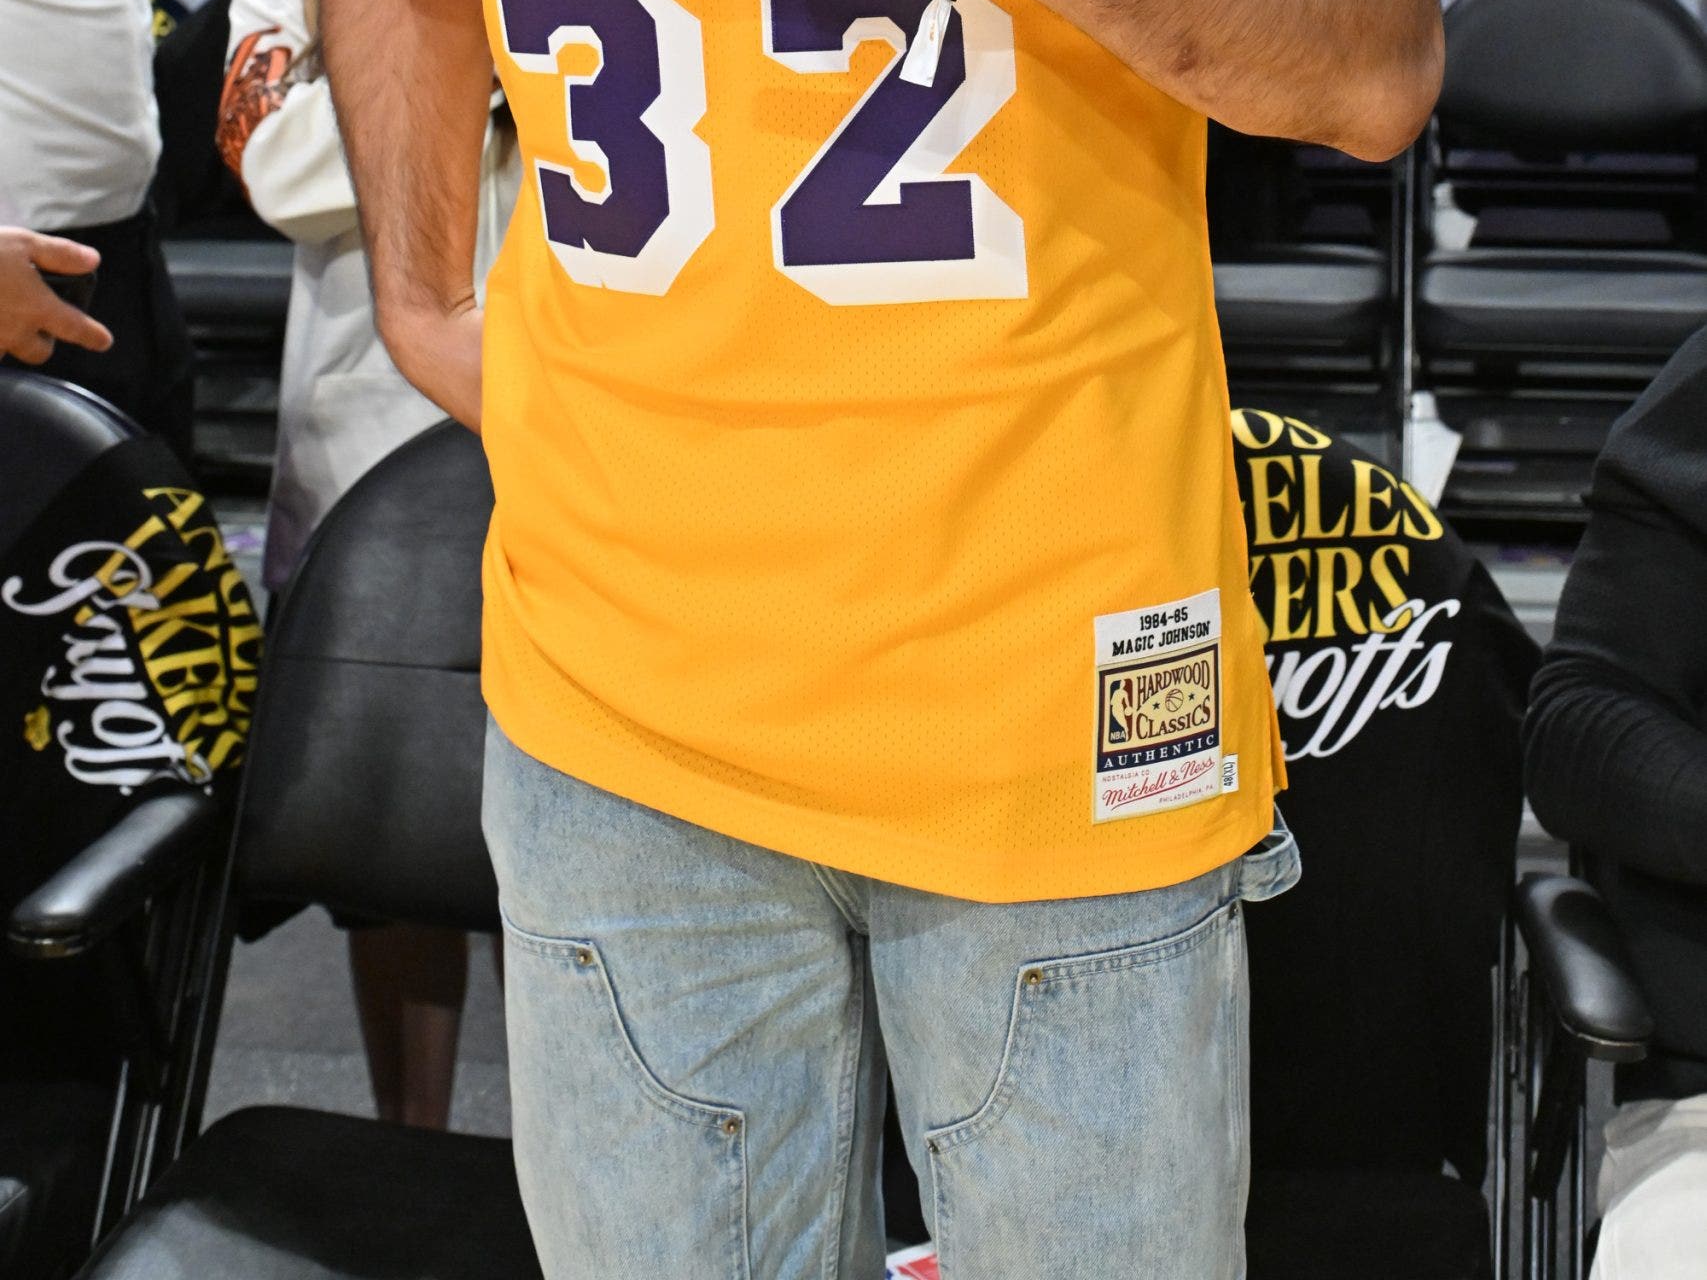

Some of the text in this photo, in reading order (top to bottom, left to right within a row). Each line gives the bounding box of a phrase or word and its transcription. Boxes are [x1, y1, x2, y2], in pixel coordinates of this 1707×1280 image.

[1243, 455, 1443, 546] ELES
[1140, 606, 1188, 631] 1984-85
[1112, 621, 1211, 657] MAGIC JOHNSON
[1136, 660, 1210, 711] HARDWOOD
[1136, 695, 1211, 740] CLASSICS
[1103, 734, 1215, 769] AUTHENTIC
[1110, 731, 1126, 741] NBA
[1102, 772, 1139, 783] NOSTALGIA
[1102, 756, 1216, 807] Mitchell & Ness
